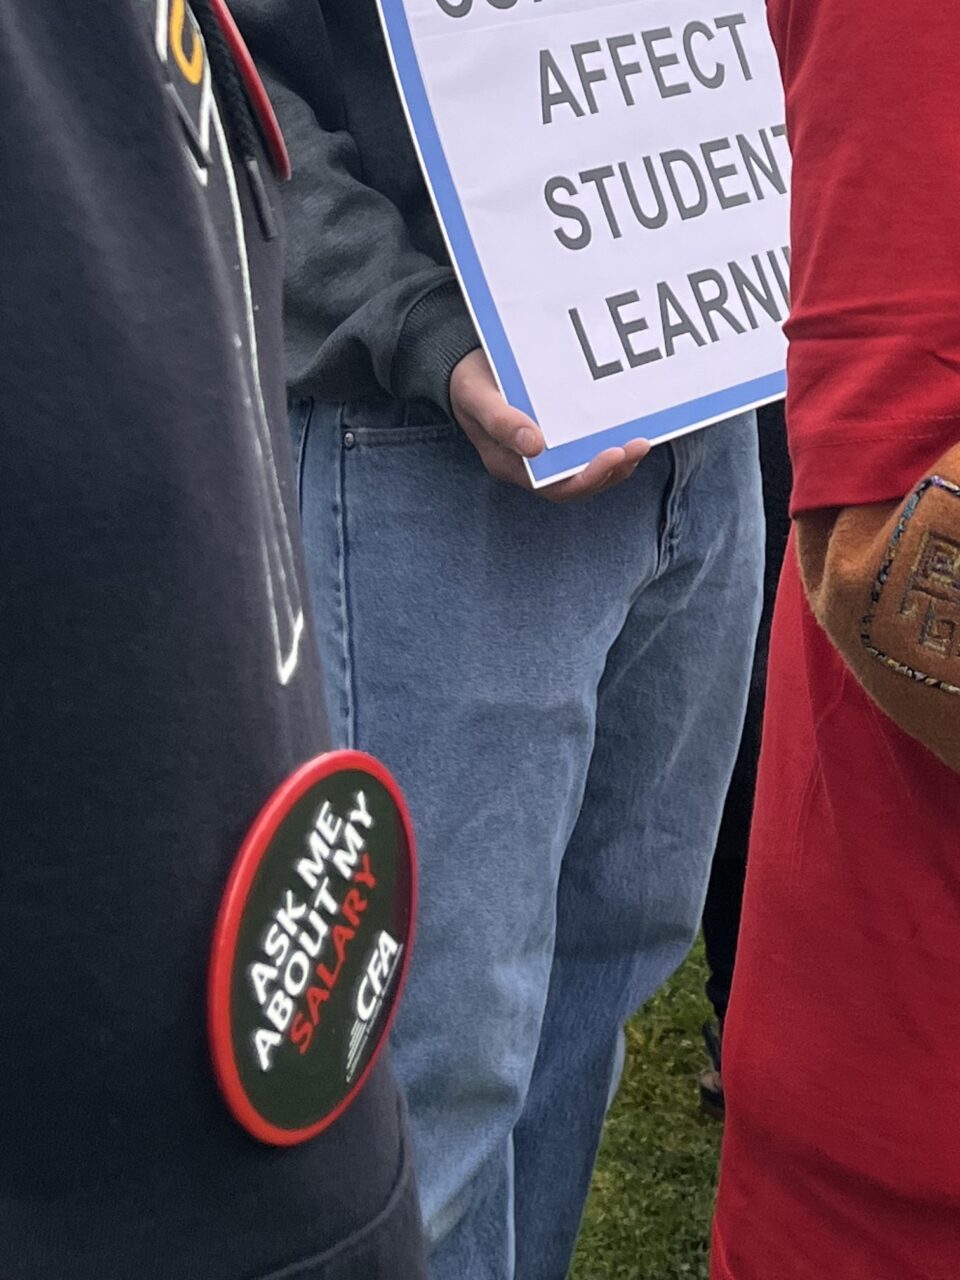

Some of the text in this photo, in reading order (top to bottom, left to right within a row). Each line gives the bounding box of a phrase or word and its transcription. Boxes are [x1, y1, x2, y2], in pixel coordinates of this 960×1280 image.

[538, 12, 753, 125] AFFECT
[567, 245, 791, 381] LEARNI
[249, 800, 344, 1006] ASK ME
[251, 876, 340, 1073] ABOUT
[332, 789, 375, 881] MY
[289, 851, 378, 1055] SALARY
[355, 929, 400, 1023] CFA
